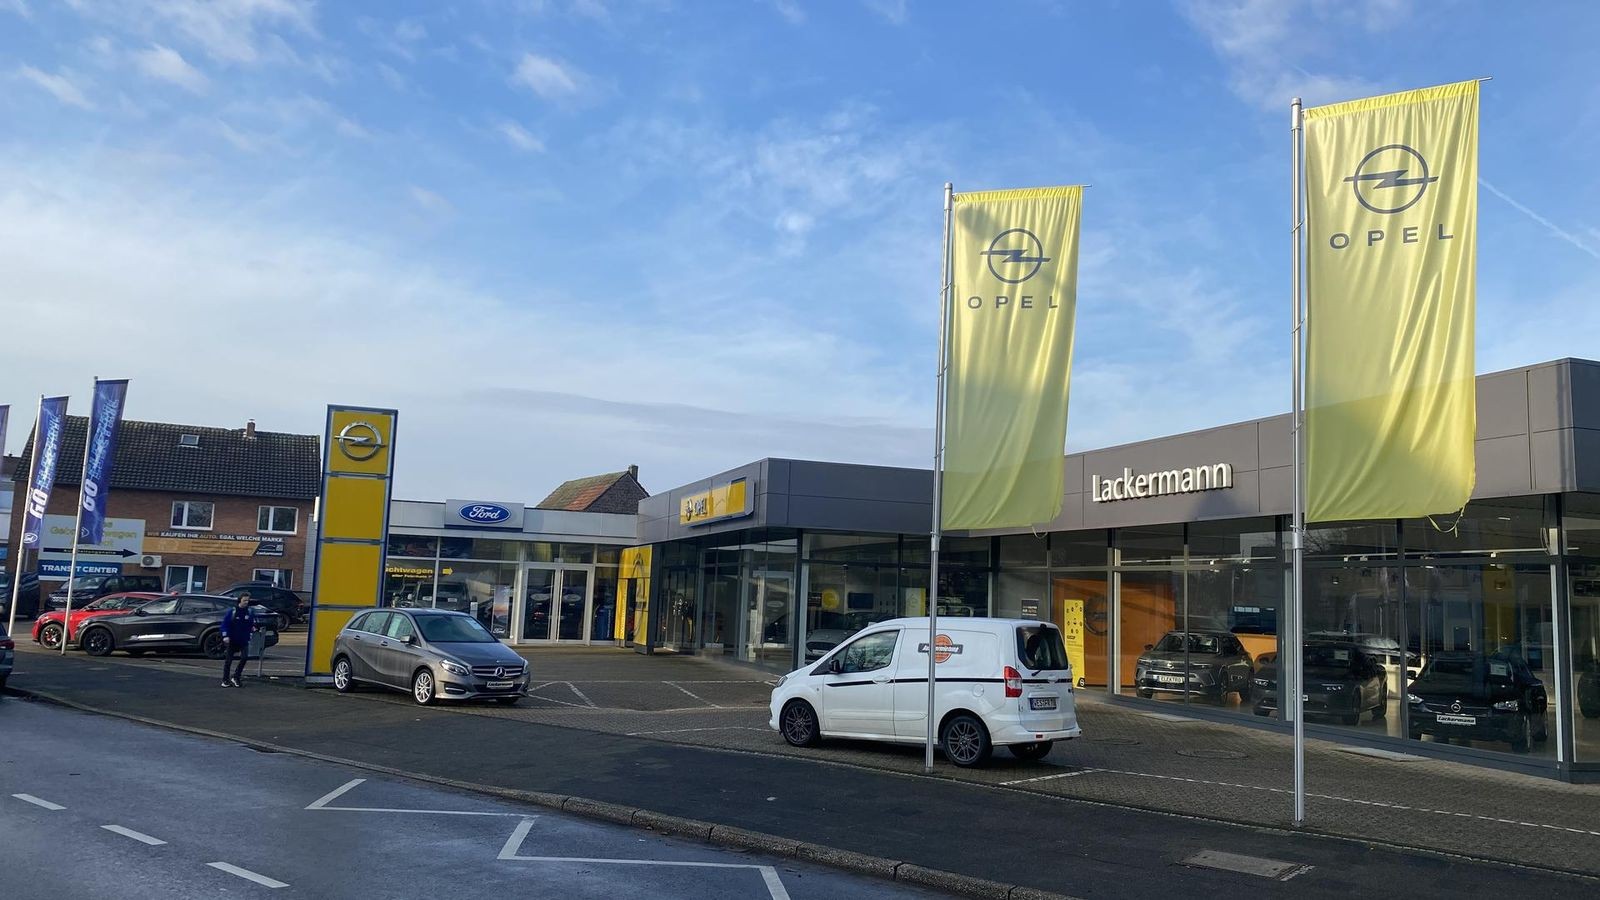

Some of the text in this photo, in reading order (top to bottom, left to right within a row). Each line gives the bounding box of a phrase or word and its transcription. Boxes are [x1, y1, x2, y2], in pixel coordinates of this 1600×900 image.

[1329, 223, 1453, 249] OPEL
[967, 295, 1058, 309] OPEL
[83, 478, 98, 512] GO
[1092, 462, 1233, 503] Lackermann
[29, 488, 48, 519] GO
[469, 505, 501, 519] Ford
[42, 564, 118, 574] TRANST CENTER
